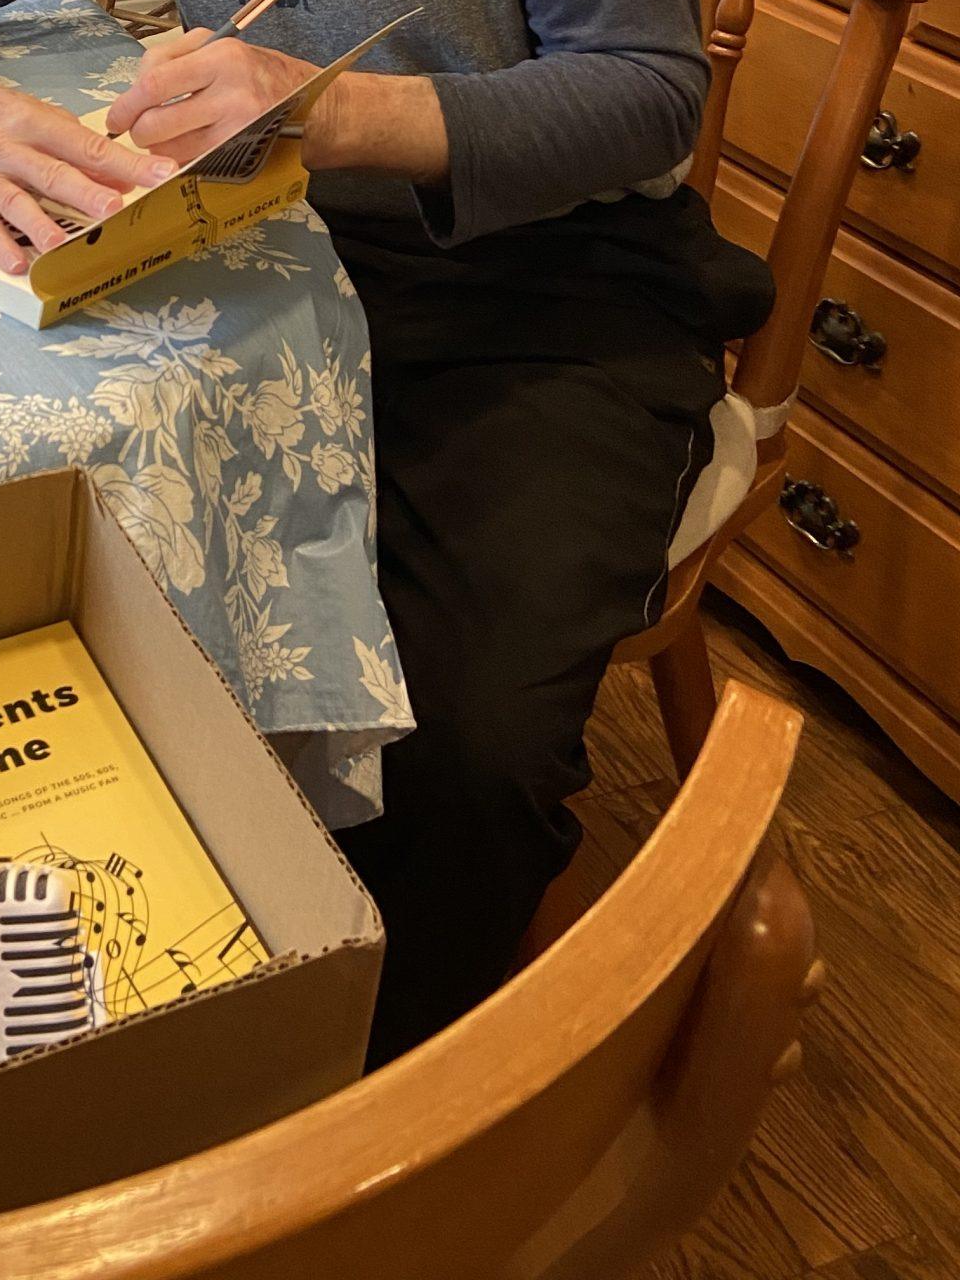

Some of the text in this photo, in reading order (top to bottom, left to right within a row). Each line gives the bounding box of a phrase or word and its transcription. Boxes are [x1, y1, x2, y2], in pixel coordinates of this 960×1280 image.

[223, 195, 281, 229] TOM LOCKE
[58, 274, 123, 312] Moments
[140, 250, 172, 273] Time
[21, 799, 52, 813] FROM
[64, 782, 97, 799] MUSIC
[99, 776, 119, 787] FAN
[34, 785, 49, 796] OF
[51, 779, 71, 790] THE
